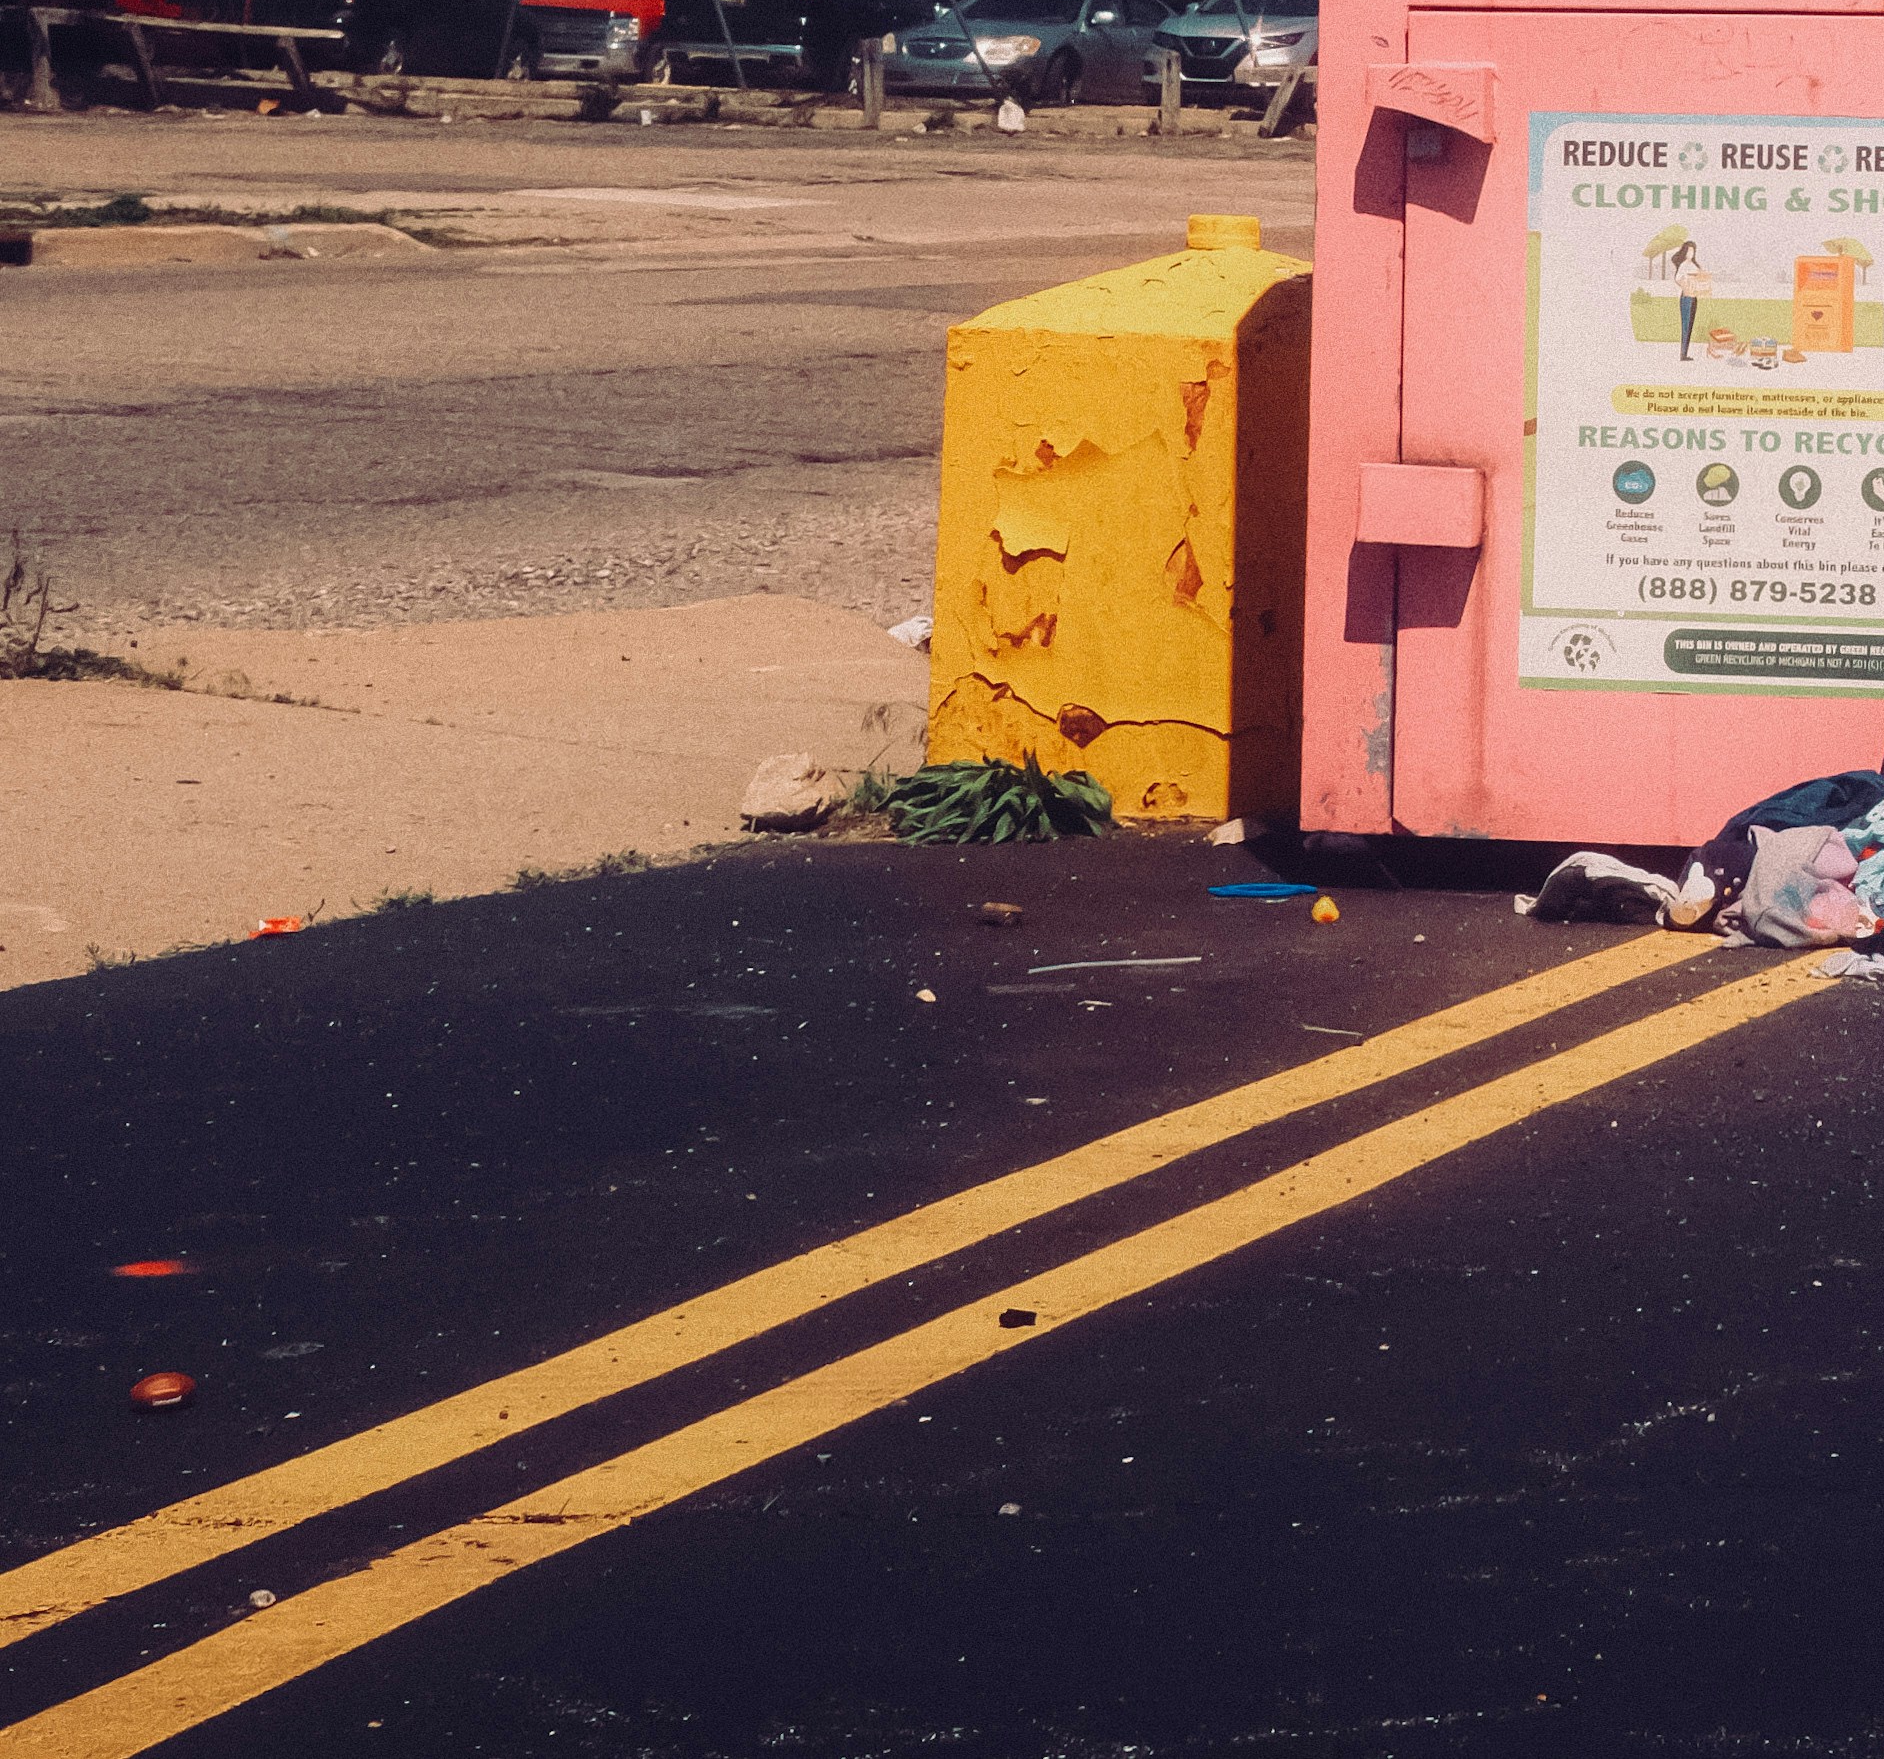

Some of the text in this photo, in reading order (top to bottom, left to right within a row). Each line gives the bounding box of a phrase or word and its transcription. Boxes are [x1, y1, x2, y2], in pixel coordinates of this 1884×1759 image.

[1563, 140, 1668, 168] REDUCE
[1721, 143, 1808, 171] REUSE
[1572, 182, 1768, 211] CLOTHING
[1784, 187, 1811, 213] &
[1625, 389, 1640, 398] We
[1643, 389, 1655, 398] do
[1659, 390, 1674, 399] not
[1678, 390, 1708, 403] accept
[1711, 390, 1758, 402] furniture,
[1762, 393, 1819, 404] mattresses,
[1823, 396, 1833, 404] or
[1647, 402, 1678, 413] Please
[1683, 403, 1694, 413] do
[1699, 404, 1713, 414] not
[1718, 404, 1742, 414] leave
[1817, 407, 1827, 417] of
[1831, 407, 1846, 417] the
[1578, 425, 1726, 451] REASONS
[1740, 429, 1782, 453] TO
[1615, 509, 1655, 519] Reduces
[1703, 511, 1731, 521] Saves
[1775, 513, 1825, 524] Conserves
[1606, 520, 1663, 532] Greenhouse
[1699, 523, 1735, 533] Landfill
[1788, 526, 1811, 536] Vital
[1702, 535, 1731, 548] Space
[1782, 538, 1816, 551] Energy
[1869, 540, 1880, 550] To
[1606, 553, 1614, 564] If
[1619, 557, 1639, 568] you
[1643, 555, 1669, 566] have
[1673, 558, 1692, 570] any
[1697, 557, 1751, 570] questions
[1756, 559, 1788, 570] about
[1793, 560, 1814, 571] this
[1819, 560, 1837, 572] bin
[1840, 562, 1878, 575] please
[1638, 575, 1876, 605] (888) 879-5238
[1675, 639, 1694, 650] THIS
[1697, 640, 1712, 650] BIN
[1714, 640, 1722, 650] IS
[1725, 641, 1756, 652] OWNED
[1758, 642, 1776, 652] AND
[1779, 643, 1823, 654] OPERATED
[1825, 644, 1837, 655] BY
[1840, 645, 1868, 656] GREEN
[1695, 653, 1721, 664] GREEN
[1723, 654, 1764, 666] RECYCLING
[1766, 655, 1776, 666] OF
[1779, 656, 1816, 668] MICHIGAN
[1818, 657, 1825, 667] IS
[1827, 658, 1842, 669] NOT
[1845, 658, 1851, 668] A
